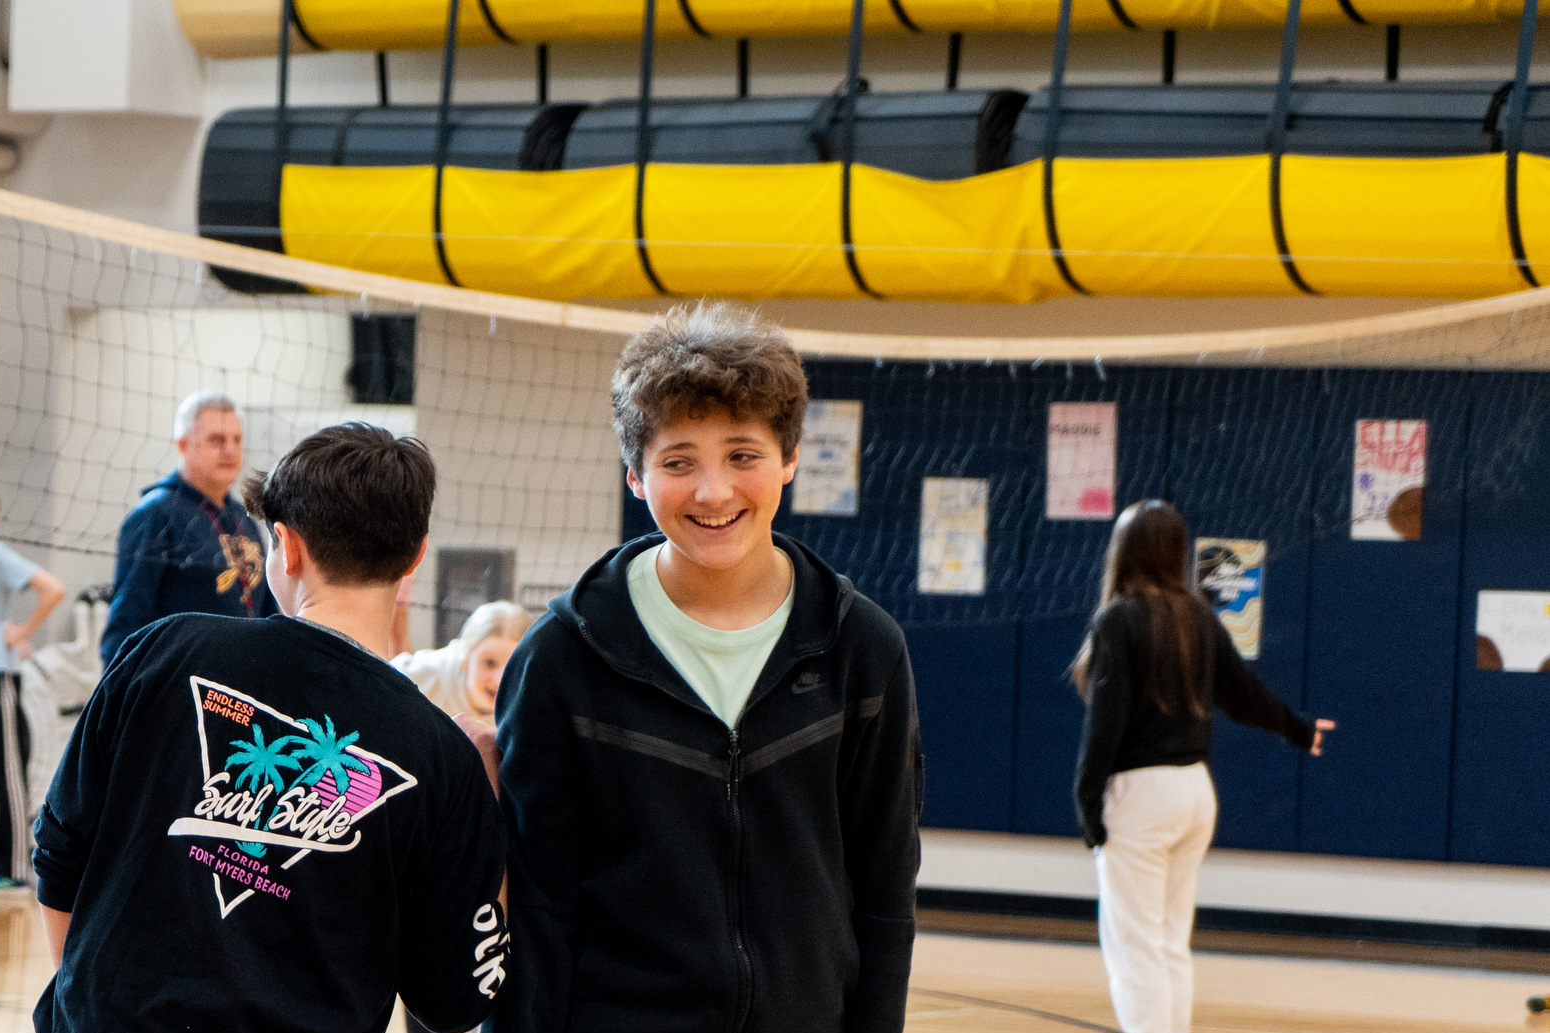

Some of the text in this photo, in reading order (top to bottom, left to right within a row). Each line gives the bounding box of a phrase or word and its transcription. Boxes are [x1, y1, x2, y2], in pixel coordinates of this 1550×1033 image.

[202, 699, 250, 727] SUMMER
[206, 689, 255, 717] ENDLESS
[194, 772, 350, 840] Surf Style
[189, 845, 291, 901] FORT MYERS BEACH
[217, 844, 269, 875] FLORIDA
